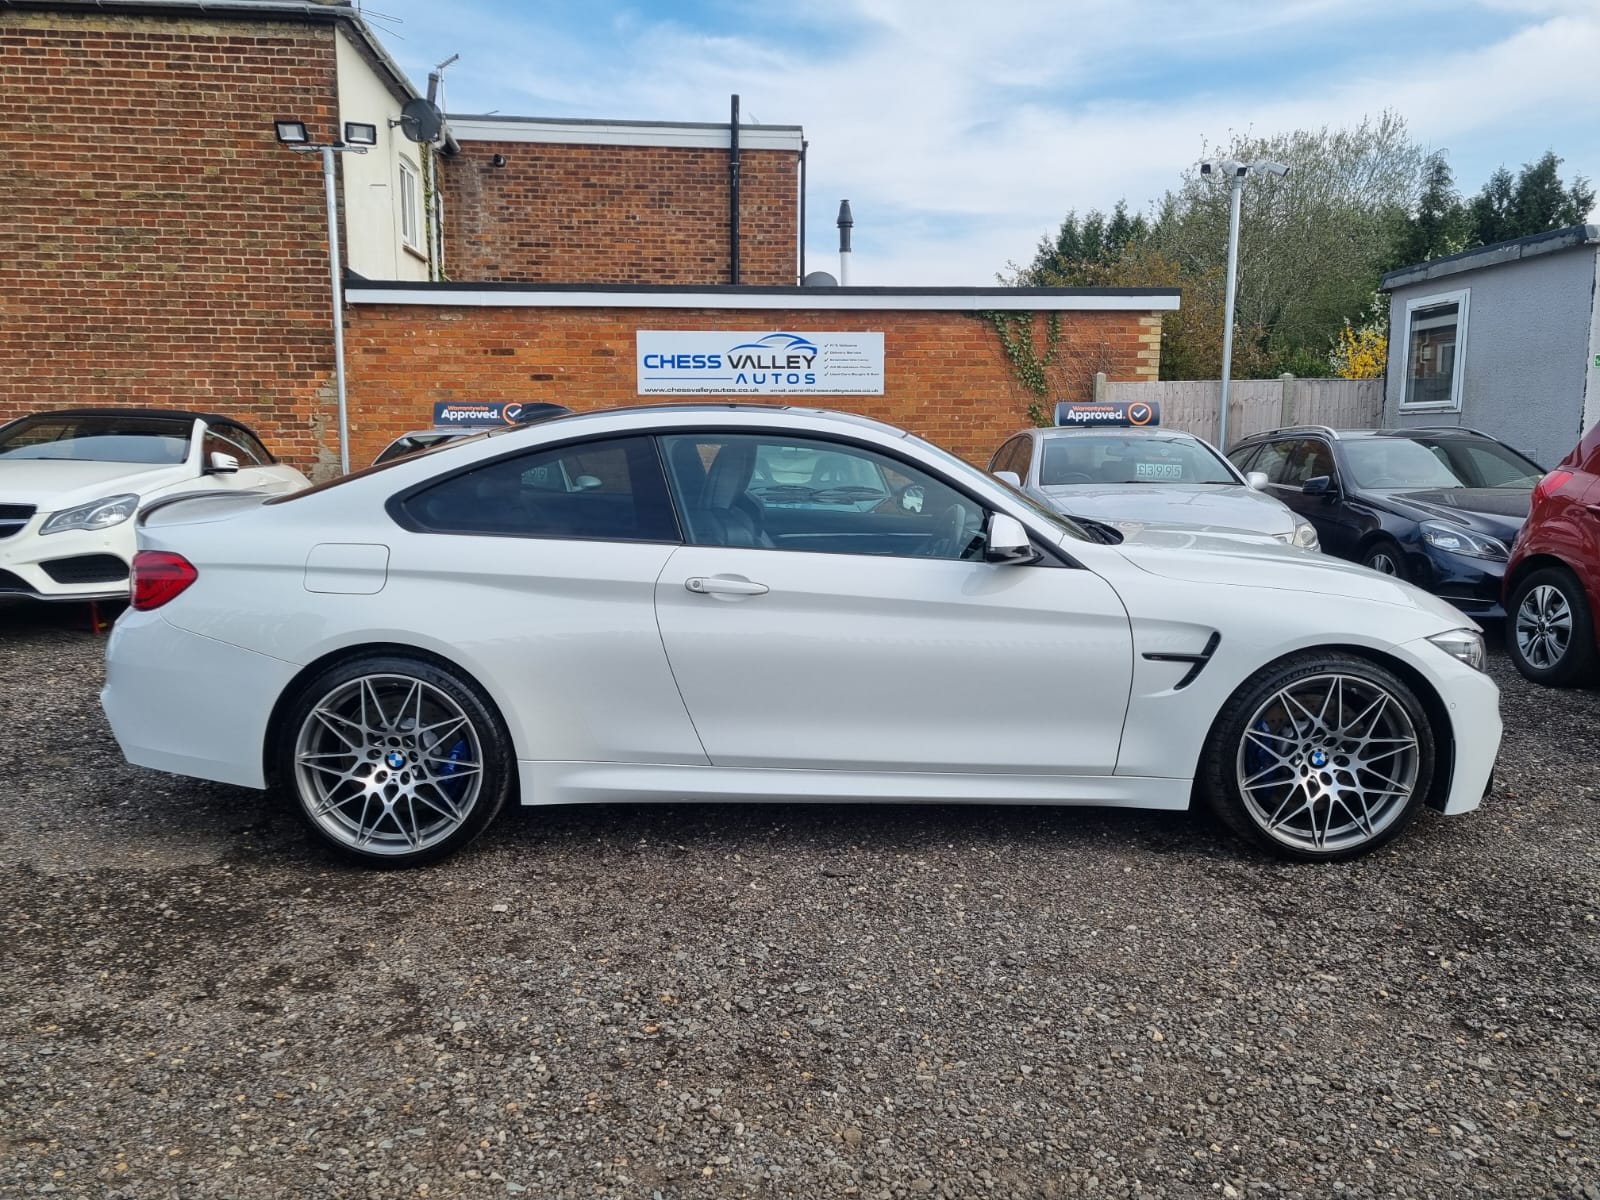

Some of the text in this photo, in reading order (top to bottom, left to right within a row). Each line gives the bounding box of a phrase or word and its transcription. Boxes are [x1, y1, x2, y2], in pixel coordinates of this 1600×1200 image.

[643, 354, 817, 370] CHESS VALLEY
[735, 373, 816, 385] AUTOS
[644, 387, 760, 395] www.chessvalleyautos.co.uk
[441, 408, 500, 421] Approved.
[1067, 409, 1126, 422] Approved.
[1137, 464, 1181, 478] £3995
